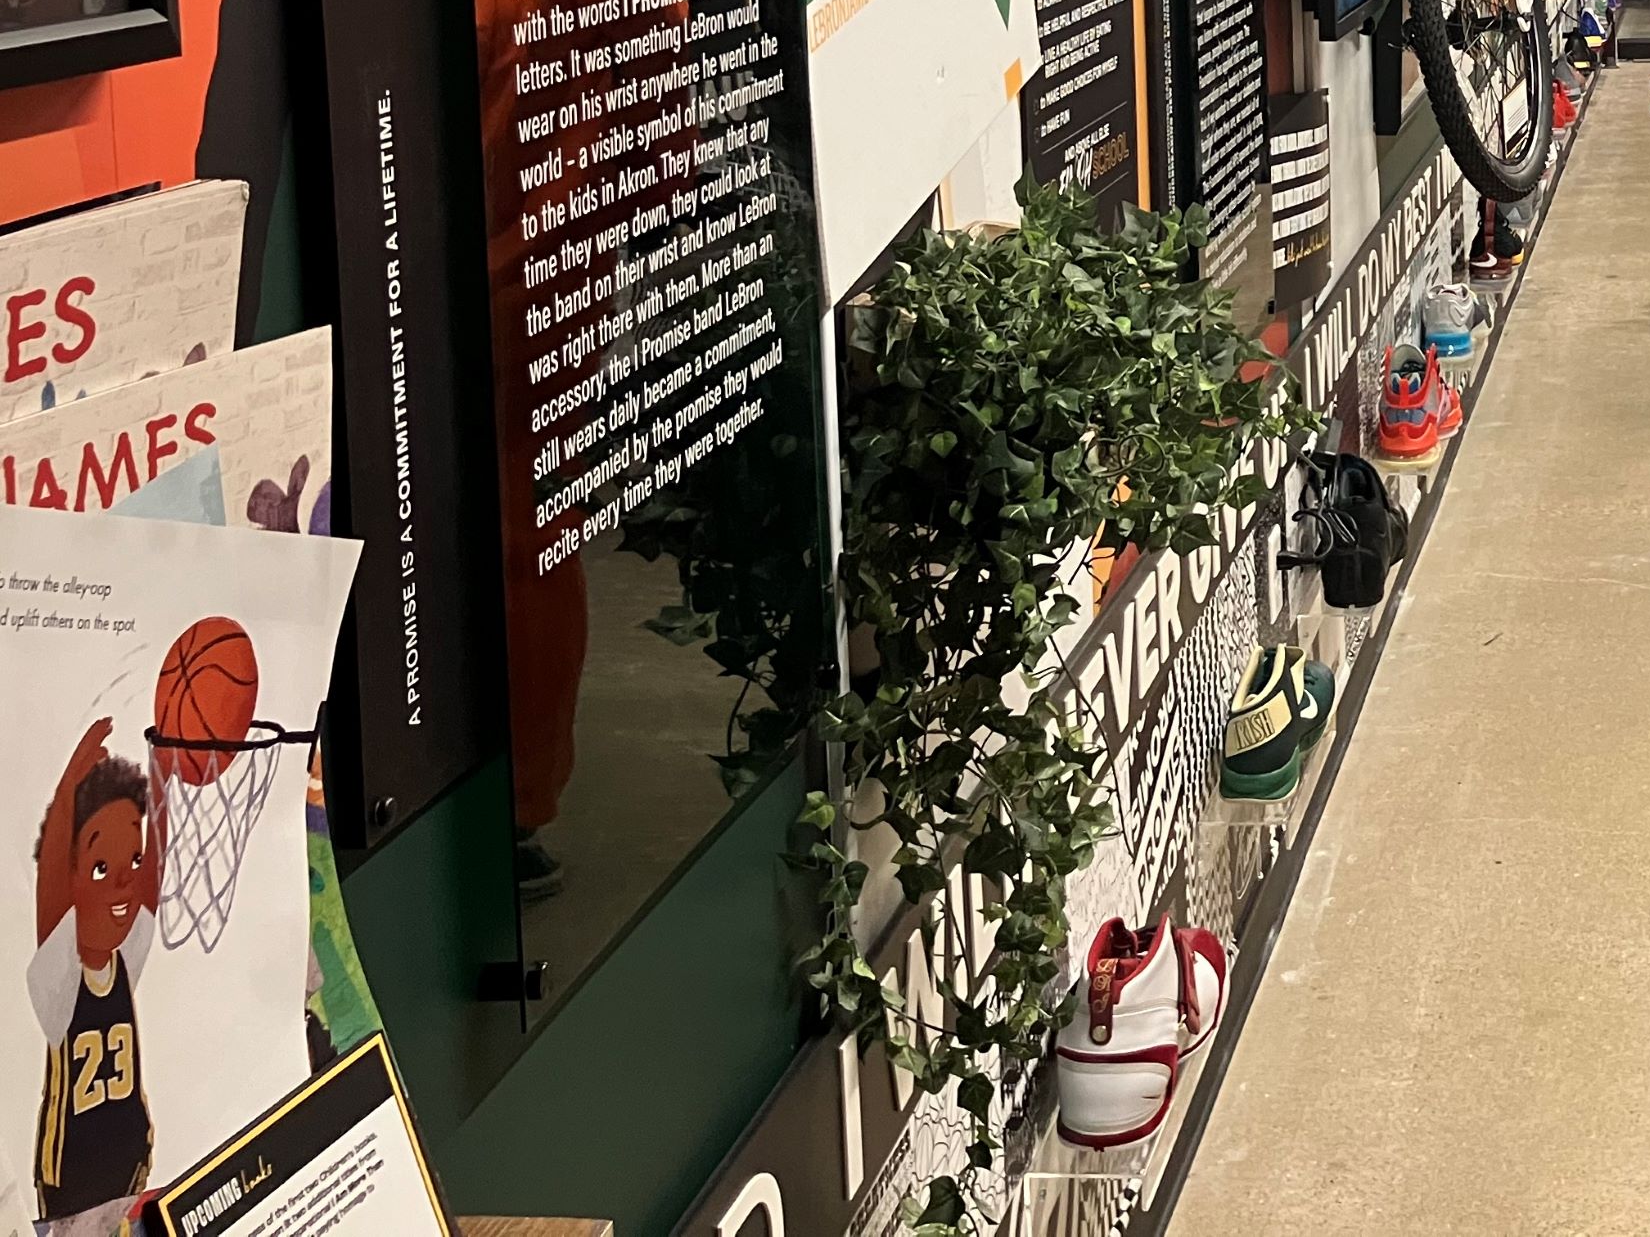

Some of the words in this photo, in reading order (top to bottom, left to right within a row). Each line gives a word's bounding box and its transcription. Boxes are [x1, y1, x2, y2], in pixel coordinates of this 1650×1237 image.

[513, 9, 547, 46] with
[550, 4, 575, 36] the
[515, 60, 567, 95] letters.
[570, 49, 582, 78] It
[583, 46, 612, 74] was
[614, 22, 681, 64] something
[683, 12, 725, 44] LeBron
[518, 110, 556, 144] wear
[559, 103, 578, 129] on
[581, 88, 602, 122] his
[604, 77, 638, 113] wrist
[640, 61, 700, 103] anywhere
[702, 52, 717, 80] he
[718, 42, 747, 73] went
[748, 37, 759, 63] in
[760, 32, 778, 59] the
[377, 89, 397, 227] LIFETIME.
[385, 231, 399, 250] A
[387, 259, 402, 317] FOR
[1314, 287, 1358, 406] WILL
[1358, 248, 1381, 338] DO
[1380, 209, 1402, 298] MY
[1403, 164, 1434, 261] BEST
[390, 326, 412, 520] COMMITMENT
[400, 524, 413, 542] A
[9, 571, 41, 592] throw
[42, 573, 60, 593] the
[401, 551, 415, 577] IS
[11, 608, 41, 633] uplift
[42, 610, 75, 630] others
[77, 617, 92, 630] on
[94, 612, 110, 631] the
[402, 582, 420, 705] PROMISE
[408, 706, 421, 725] A
[72, 1022, 134, 1116] 23
[180, 1176, 243, 1237] UPCOMING
